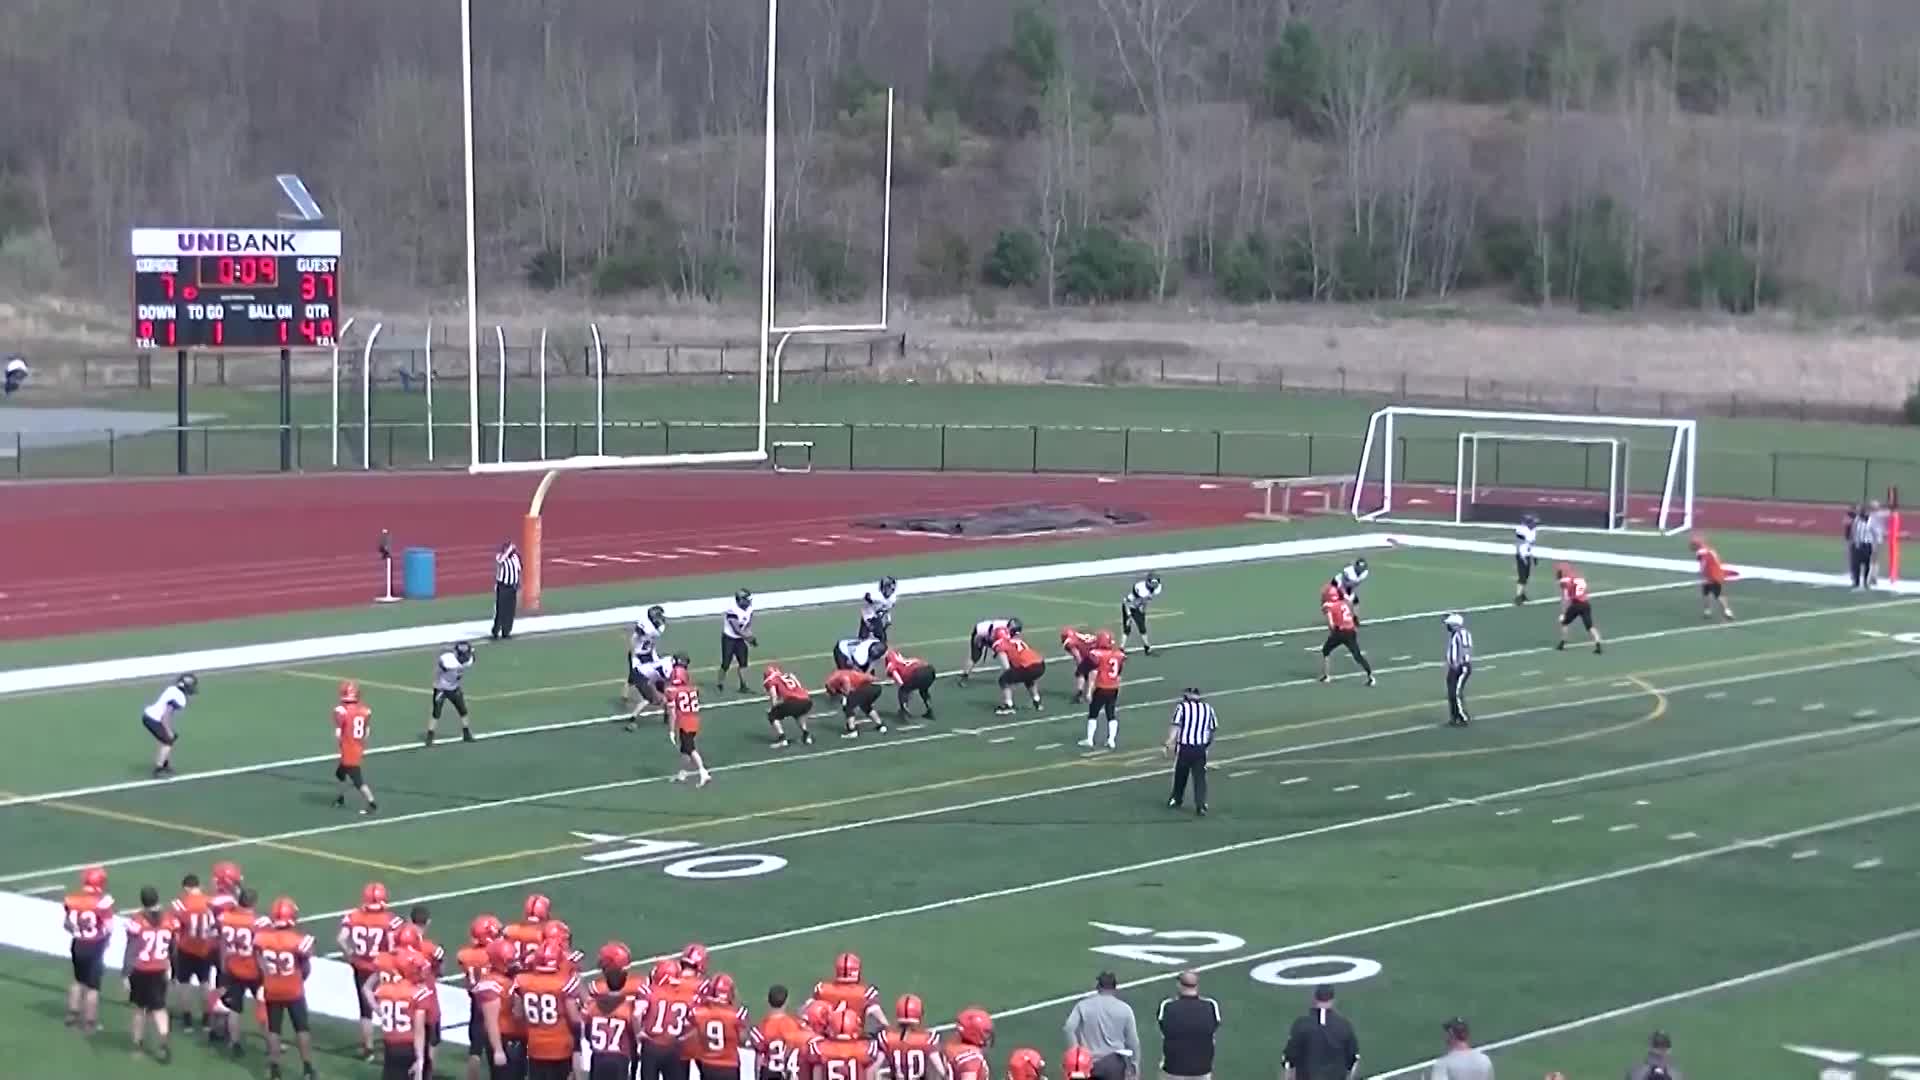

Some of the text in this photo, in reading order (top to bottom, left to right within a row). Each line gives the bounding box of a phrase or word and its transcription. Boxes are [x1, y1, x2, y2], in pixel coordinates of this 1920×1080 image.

[178, 232, 296, 252] UNIBANK
[218, 257, 275, 285] 0:09
[297, 258, 336, 272] GUEST
[302, 272, 333, 300] 37
[138, 304, 176, 319] DOWN
[187, 304, 204, 319] TO
[206, 304, 224, 319] GO
[248, 304, 275, 319] BALL
[277, 304, 293, 319] ON
[305, 304, 330, 318] QTR
[1108, 658, 1118, 678] 3
[678, 690, 699, 713] 22
[353, 716, 365, 739] 8
[139, 929, 172, 961] 76
[380, 1000, 411, 1032] 85
[523, 992, 558, 1025] 68
[652, 999, 686, 1036] 13
[591, 1017, 626, 1051] 57
[706, 1020, 725, 1050] 9
[768, 1040, 800, 1080] 24
[893, 1049, 925, 1080] 10
